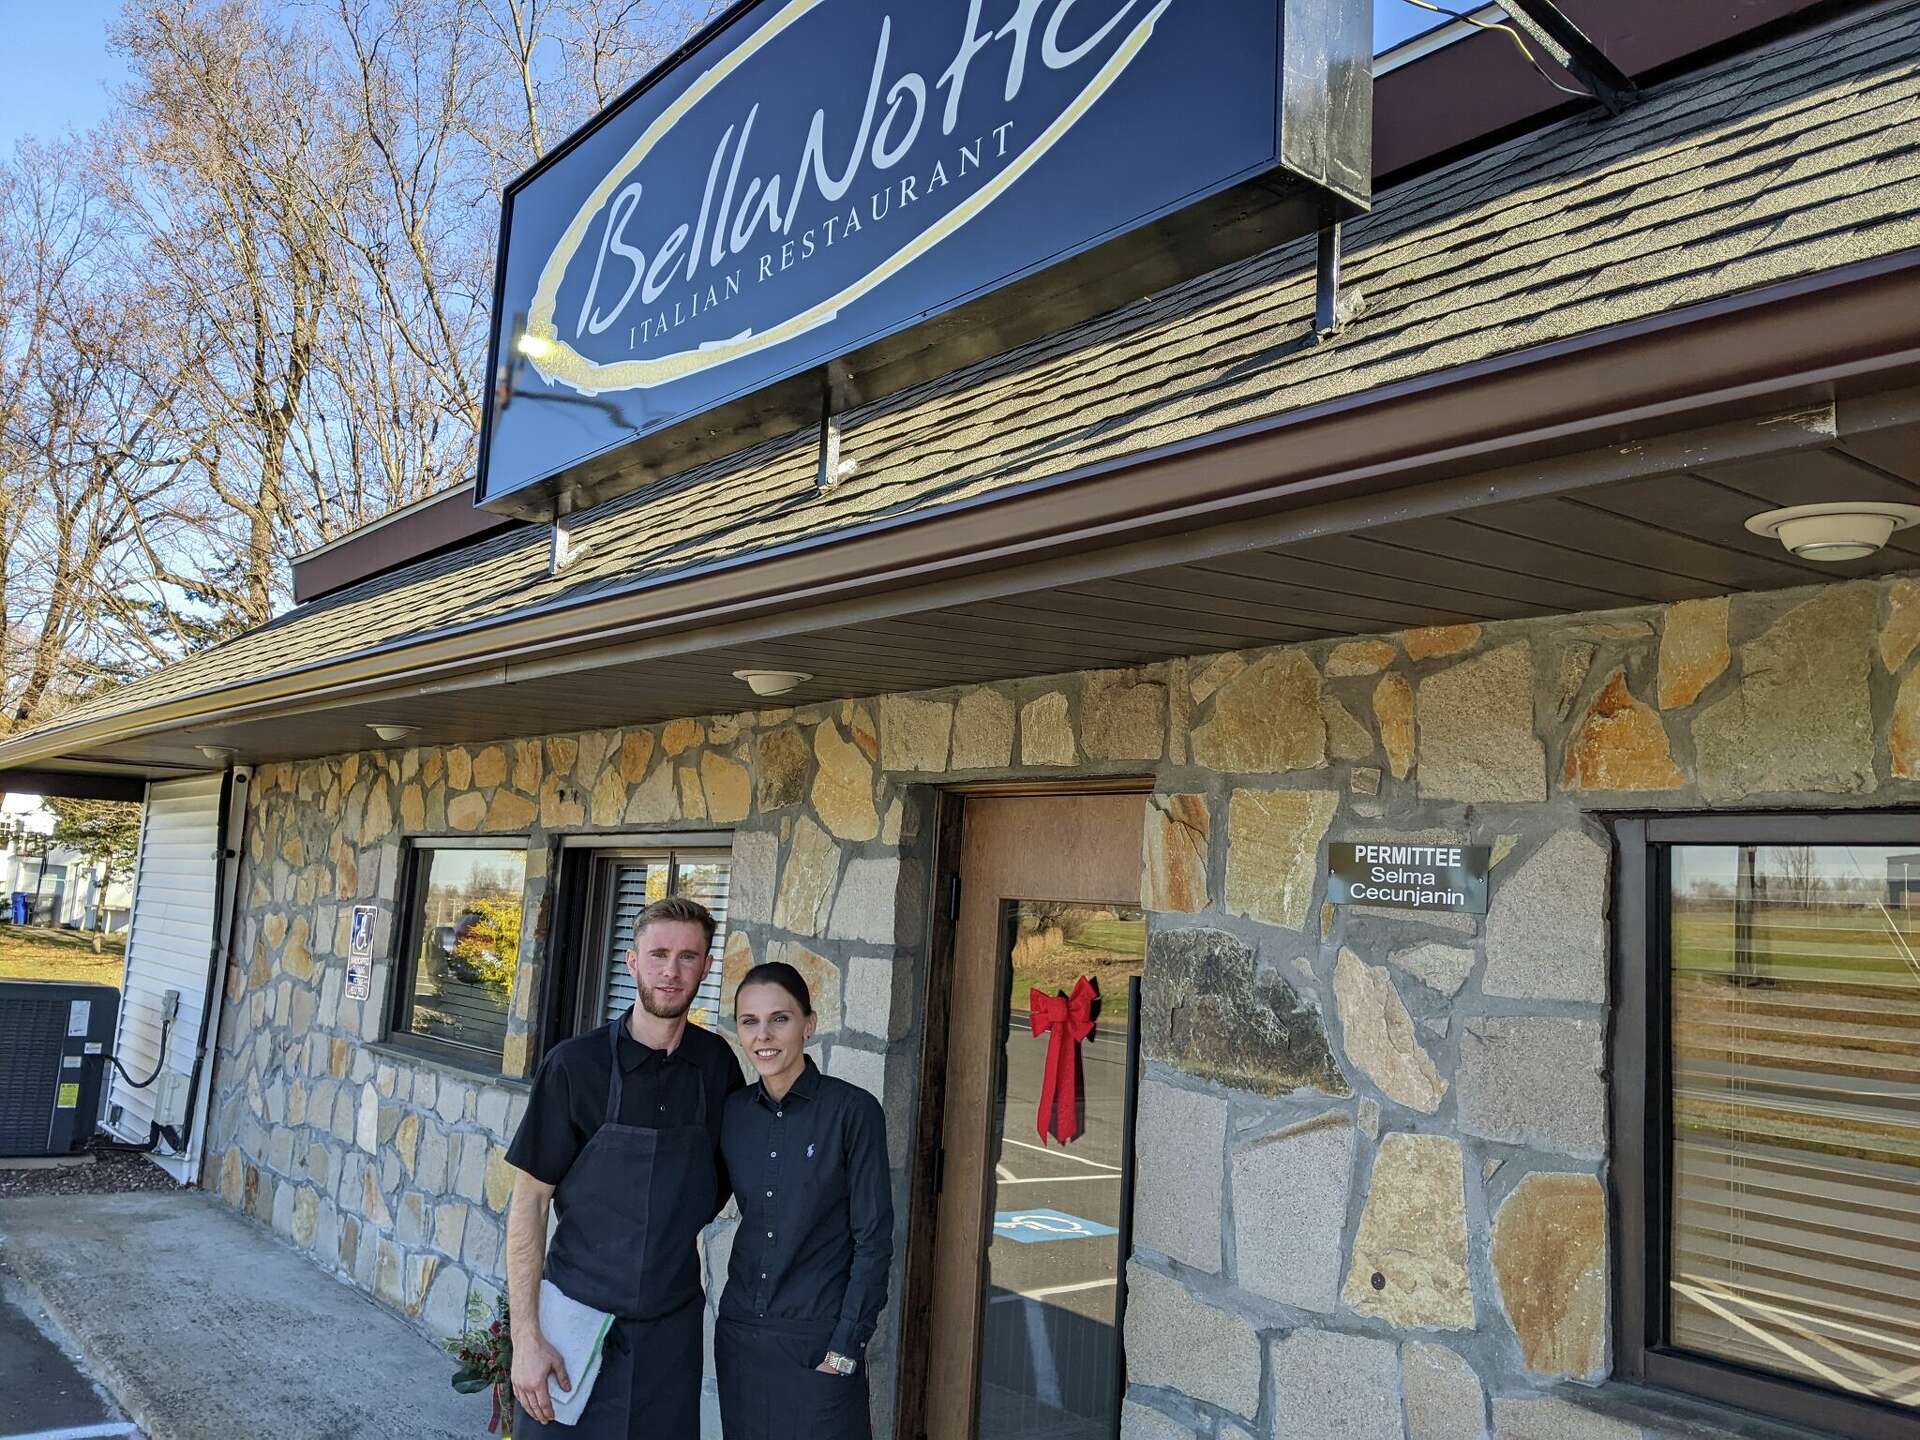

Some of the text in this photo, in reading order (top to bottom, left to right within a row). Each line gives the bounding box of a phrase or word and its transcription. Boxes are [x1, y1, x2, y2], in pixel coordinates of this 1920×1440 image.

[627, 121, 1013, 350] ITALIAN RESTAURANT
[1355, 845, 1461, 867] PERMITTEE
[1371, 867, 1435, 885] Selma
[1350, 883, 1464, 906] Cecunjanin
